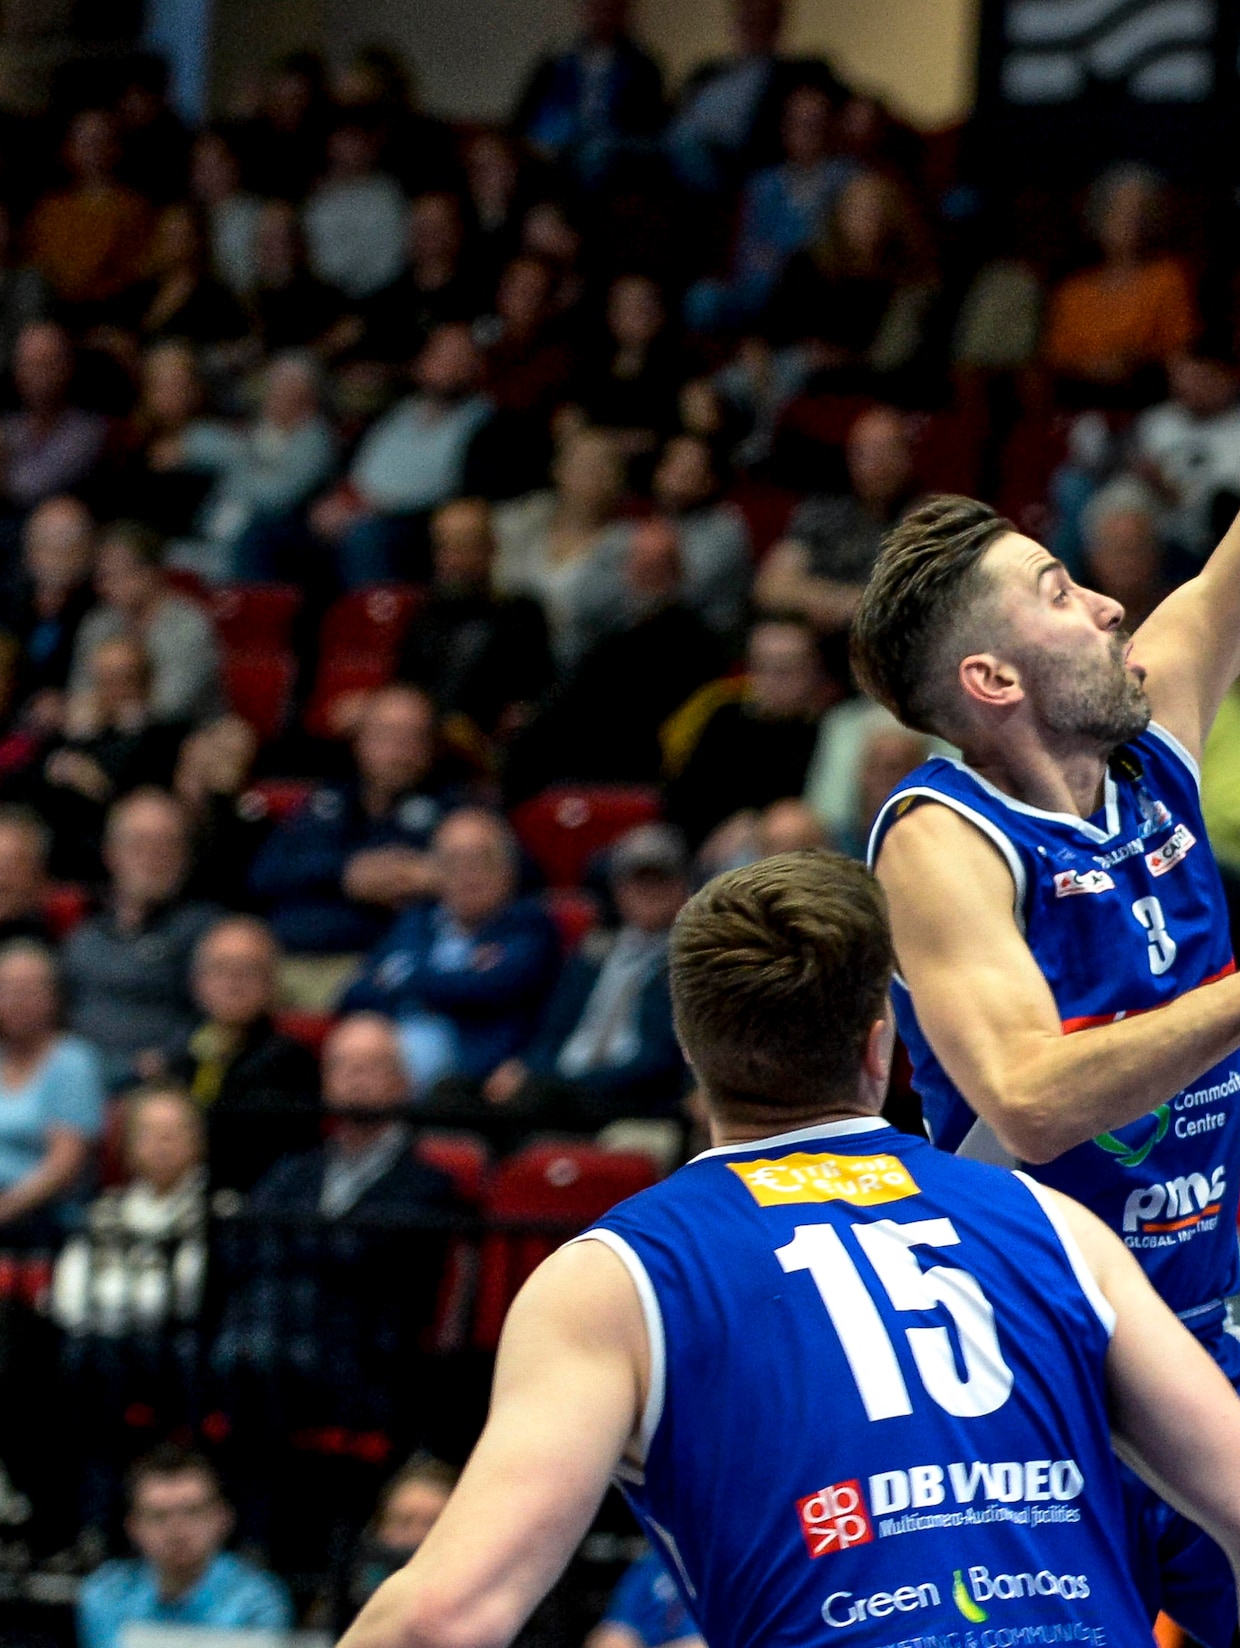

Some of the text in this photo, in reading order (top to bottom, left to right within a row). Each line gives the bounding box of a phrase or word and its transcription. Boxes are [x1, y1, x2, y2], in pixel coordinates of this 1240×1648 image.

[1131, 896, 1177, 975] 3
[1175, 1112, 1226, 1138] Centre
[1125, 1234, 1176, 1248] GLOBAL
[774, 1218, 1015, 1422] 15
[868, 1465, 945, 1517] DB
[820, 1565, 1091, 1628] Green Banaas
